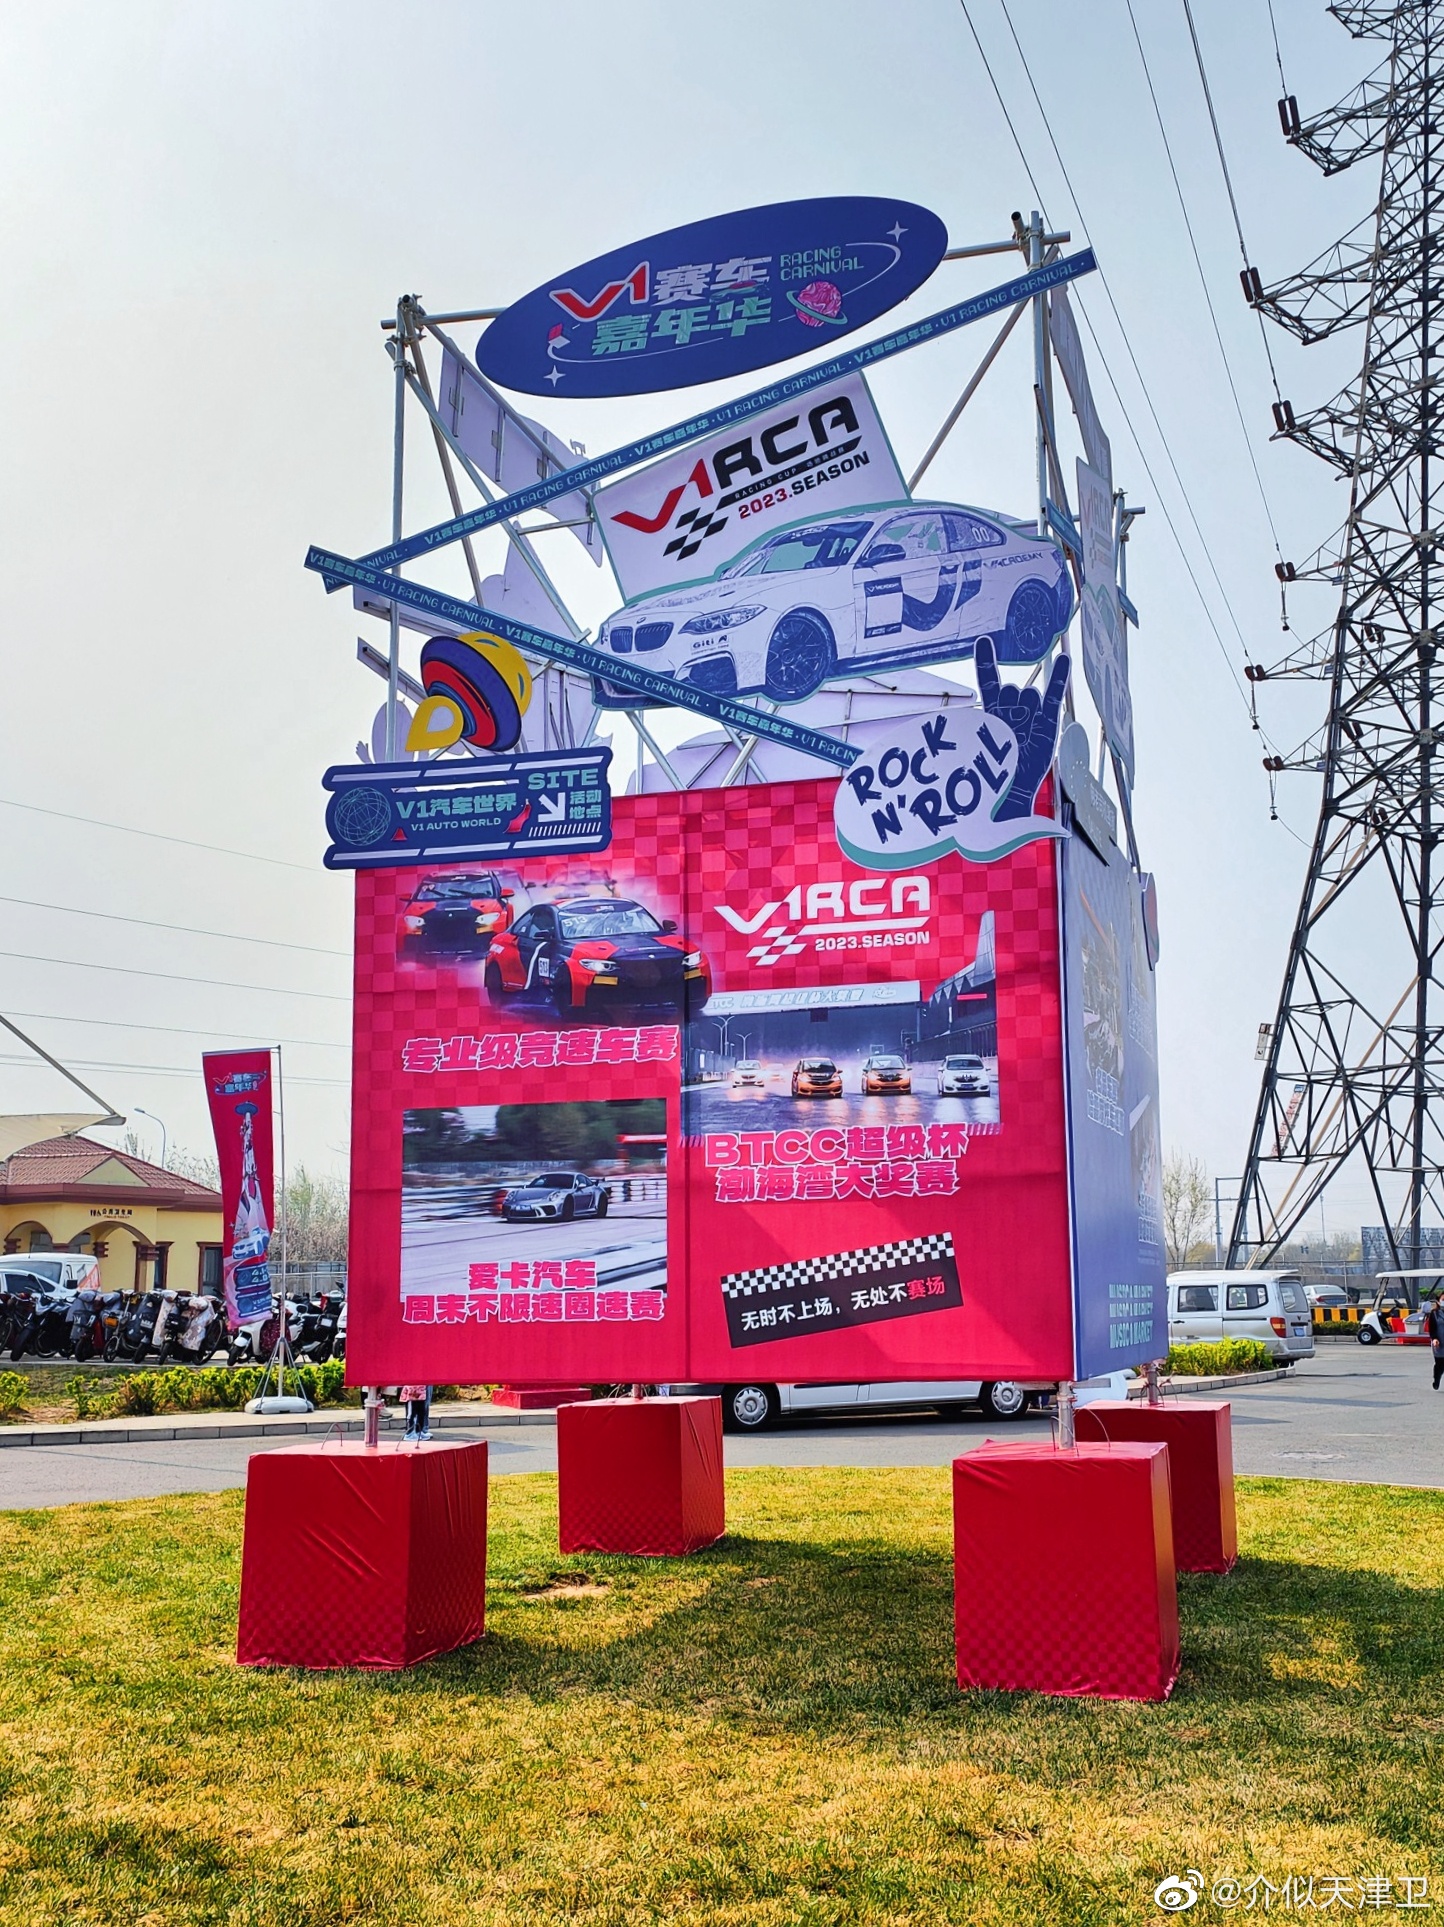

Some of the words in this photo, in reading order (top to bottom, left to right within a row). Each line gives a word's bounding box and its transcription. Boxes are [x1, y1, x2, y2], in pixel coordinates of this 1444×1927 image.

[780, 246, 842, 267] RACING
[780, 258, 864, 282] CARNIVAL
[591, 296, 773, 356] 嘉年华
[520, 480, 564, 510] RACING
[566, 456, 626, 486] CARNIVAL
[734, 388, 780, 415] RACING
[783, 362, 845, 395] CARNIVAL
[959, 291, 1007, 320] RACING
[1011, 263, 1078, 298] CARNIVAL
[735, 479, 772, 499] RACING
[777, 467, 797, 481] CUP
[738, 450, 871, 519] 2023.SEASON
[397, 585, 439, 608] RACING
[441, 596, 496, 630] CARNIVAL
[598, 661, 642, 684] RACING
[644, 677, 702, 707] CARNIVAL
[817, 740, 860, 763] RACIN
[846, 714, 957, 806] ROCK
[527, 768, 599, 790] SITE
[396, 792, 517, 819] V1汽车世界
[569, 790, 602, 804] 活动
[569, 804, 602, 819] 地点
[411, 823, 424, 831] V1
[426, 820, 459, 831] AUTO
[461, 817, 501, 828] WORLD
[815, 931, 930, 951] 2023.SEASON
[402, 1025, 680, 1073] 专业级竞速车赛
[705, 1121, 970, 1167] BTCC超级杯
[715, 1159, 961, 1202] 渤海湾大奖赛
[467, 1260, 598, 1291] 爱卡汽车
[402, 1290, 665, 1323] 周末不限速圈速赛
